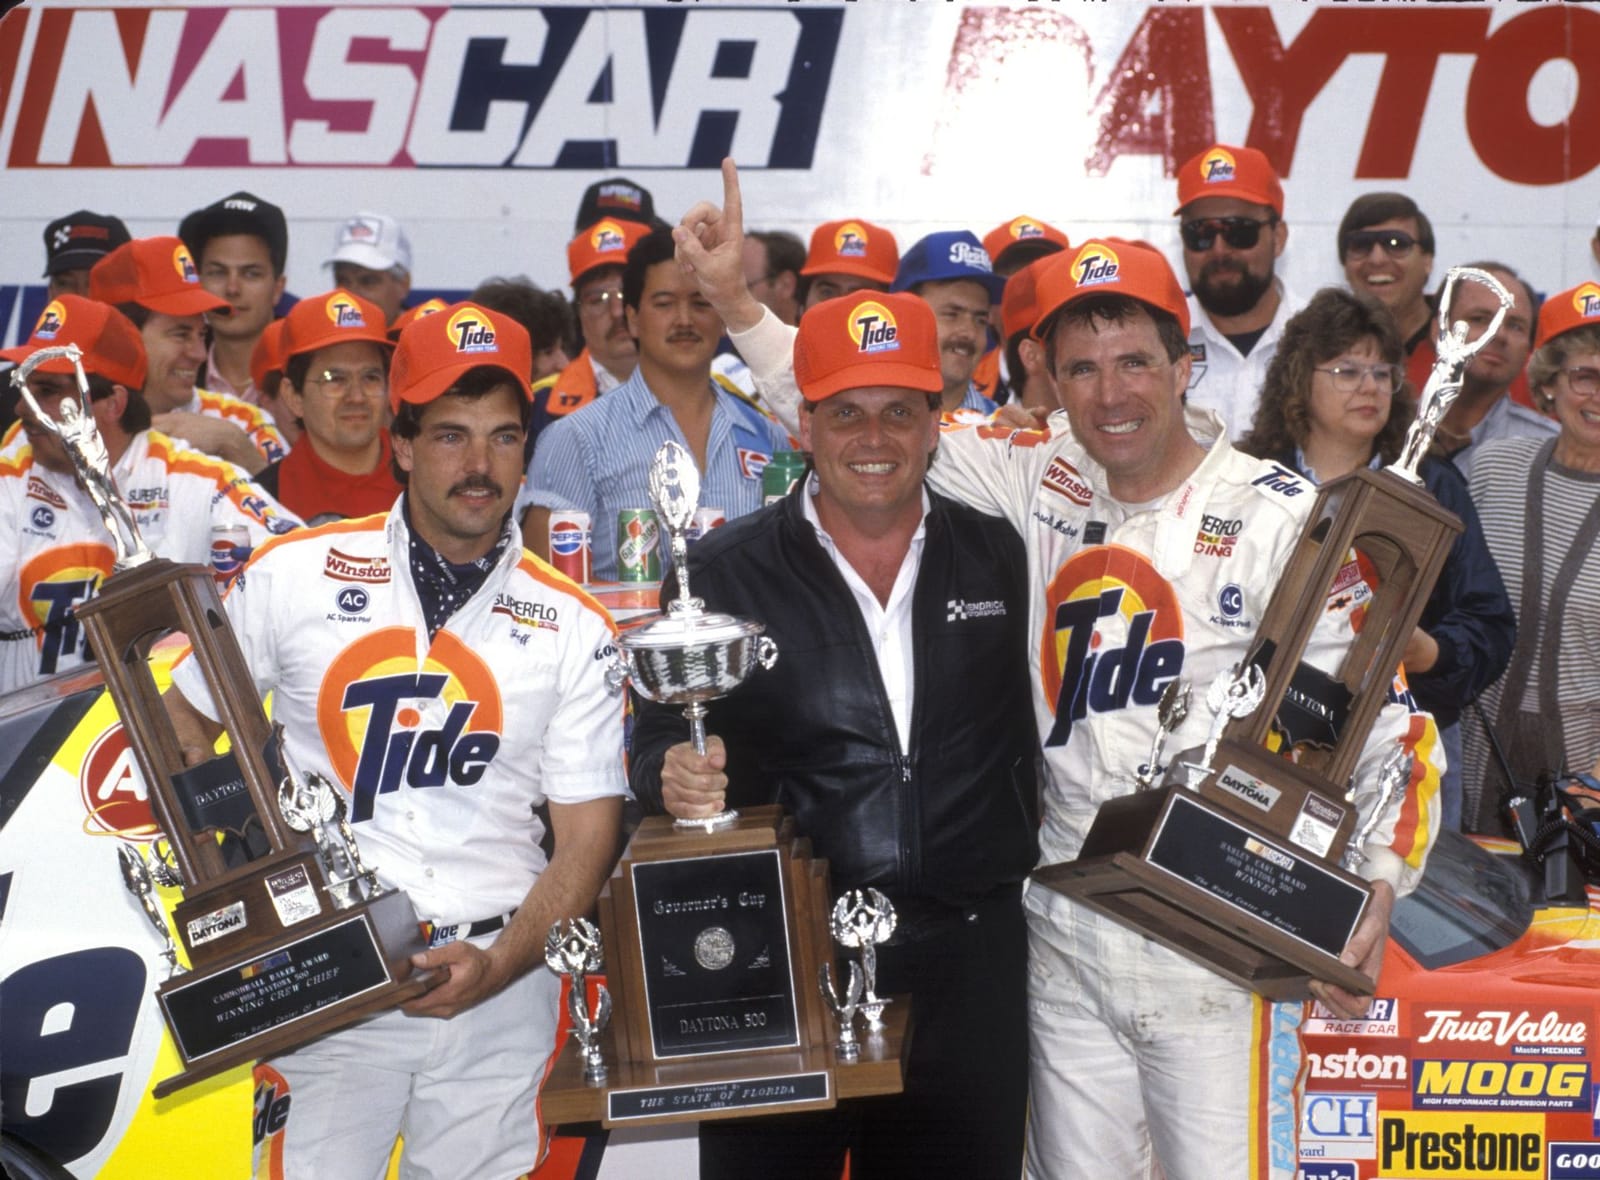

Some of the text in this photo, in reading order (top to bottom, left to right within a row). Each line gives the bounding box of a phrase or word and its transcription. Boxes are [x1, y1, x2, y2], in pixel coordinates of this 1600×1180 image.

[36, 9, 802, 166] NASCAR
[1207, 159, 1233, 180] Tide
[597, 231, 622, 249] Tide
[840, 233, 865, 252] Tide
[1078, 256, 1119, 285] Tide
[333, 304, 362, 326] Tide
[456, 320, 494, 350] Tide
[857, 315, 897, 351] Tide
[1251, 465, 1304, 497] Tide
[34, 510, 51, 524] AC
[551, 531, 583, 542] PEPSI
[327, 555, 391, 577] Winston
[341, 592, 365, 607] AC
[494, 593, 557, 621] SUPERFLO
[1222, 591, 1241, 609] AC
[1044, 587, 1185, 748] Tide
[342, 673, 500, 824] Tide
[195, 779, 249, 806] DAYTON
[1221, 775, 1270, 807] DAYTONA
[1235, 869, 1278, 896] WINNER
[1279, 872, 1307, 891] AWARD
[653, 891, 766, 915] Governor's Cup
[191, 915, 241, 942] DAYTONA
[268, 965, 296, 981] BAKER
[301, 952, 330, 968] AWARD
[216, 966, 340, 1023] WINNING CREW CHIEF
[680, 1011, 767, 1034] DAYTONA 500
[1324, 1023, 1396, 1034] RACE CAR
[1417, 1010, 1587, 1047] True Value
[1515, 1046, 1582, 1055] Master MECHANIC
[1416, 1060, 1587, 1097] MOOG
[640, 1085, 796, 1108] THE STATE OF FLORIDA
[1422, 1097, 1441, 1105] HIGH
[1442, 1098, 1498, 1106] PERFORMANCE
[1499, 1099, 1547, 1107] SUSPENSION
[1382, 1117, 1541, 1171] Prestone
